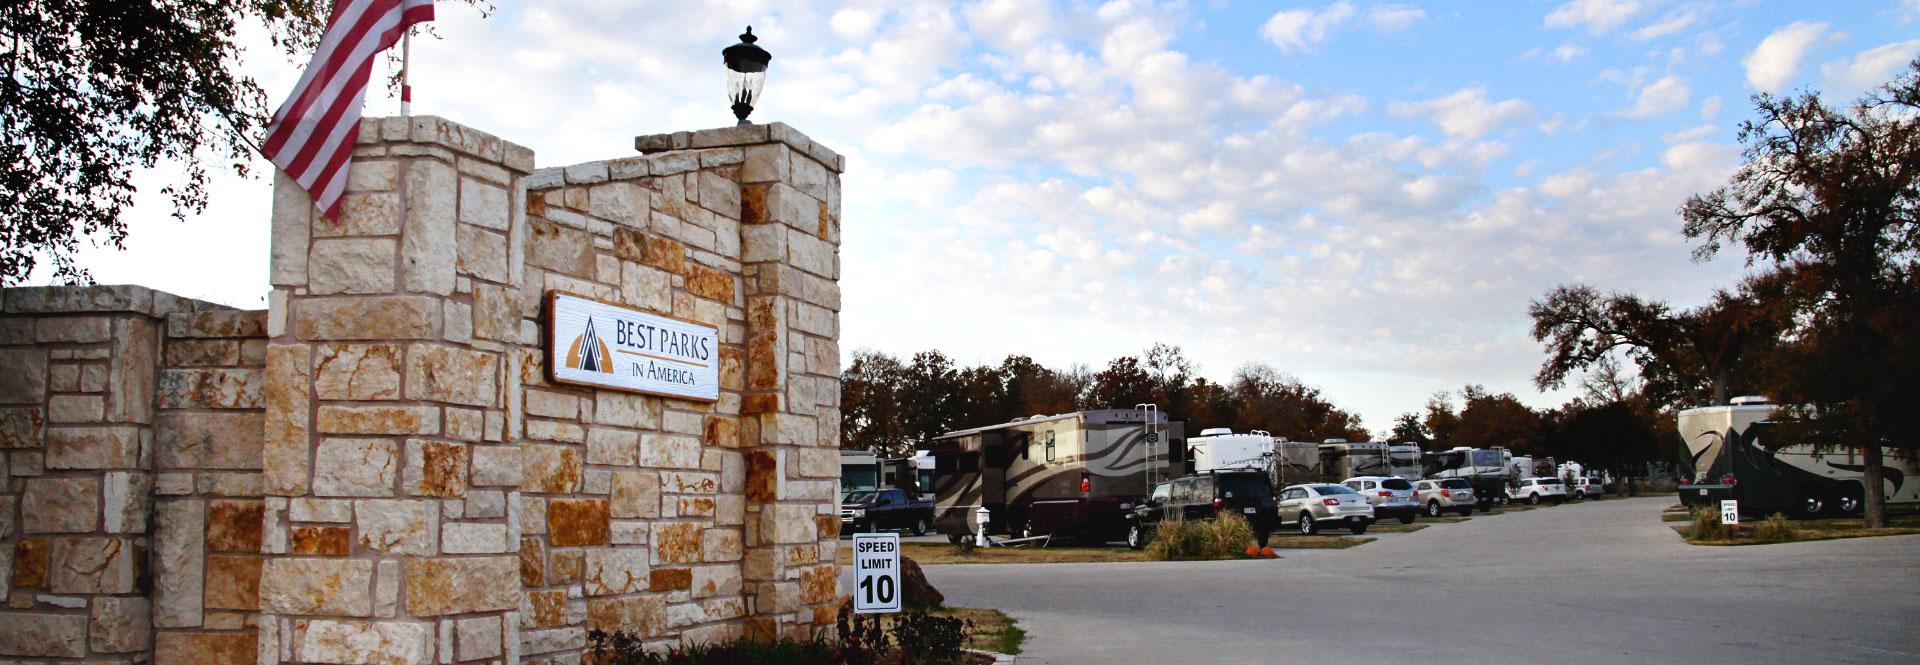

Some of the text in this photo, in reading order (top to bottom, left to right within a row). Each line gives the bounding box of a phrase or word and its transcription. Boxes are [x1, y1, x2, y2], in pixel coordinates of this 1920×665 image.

[616, 319, 709, 361] BEST PARKS
[632, 360, 695, 386] IN AMERICA
[1724, 512, 1735, 521] 10
[858, 542, 894, 553] SPEED
[861, 559, 892, 569] LIMIT
[860, 575, 894, 604] 10
